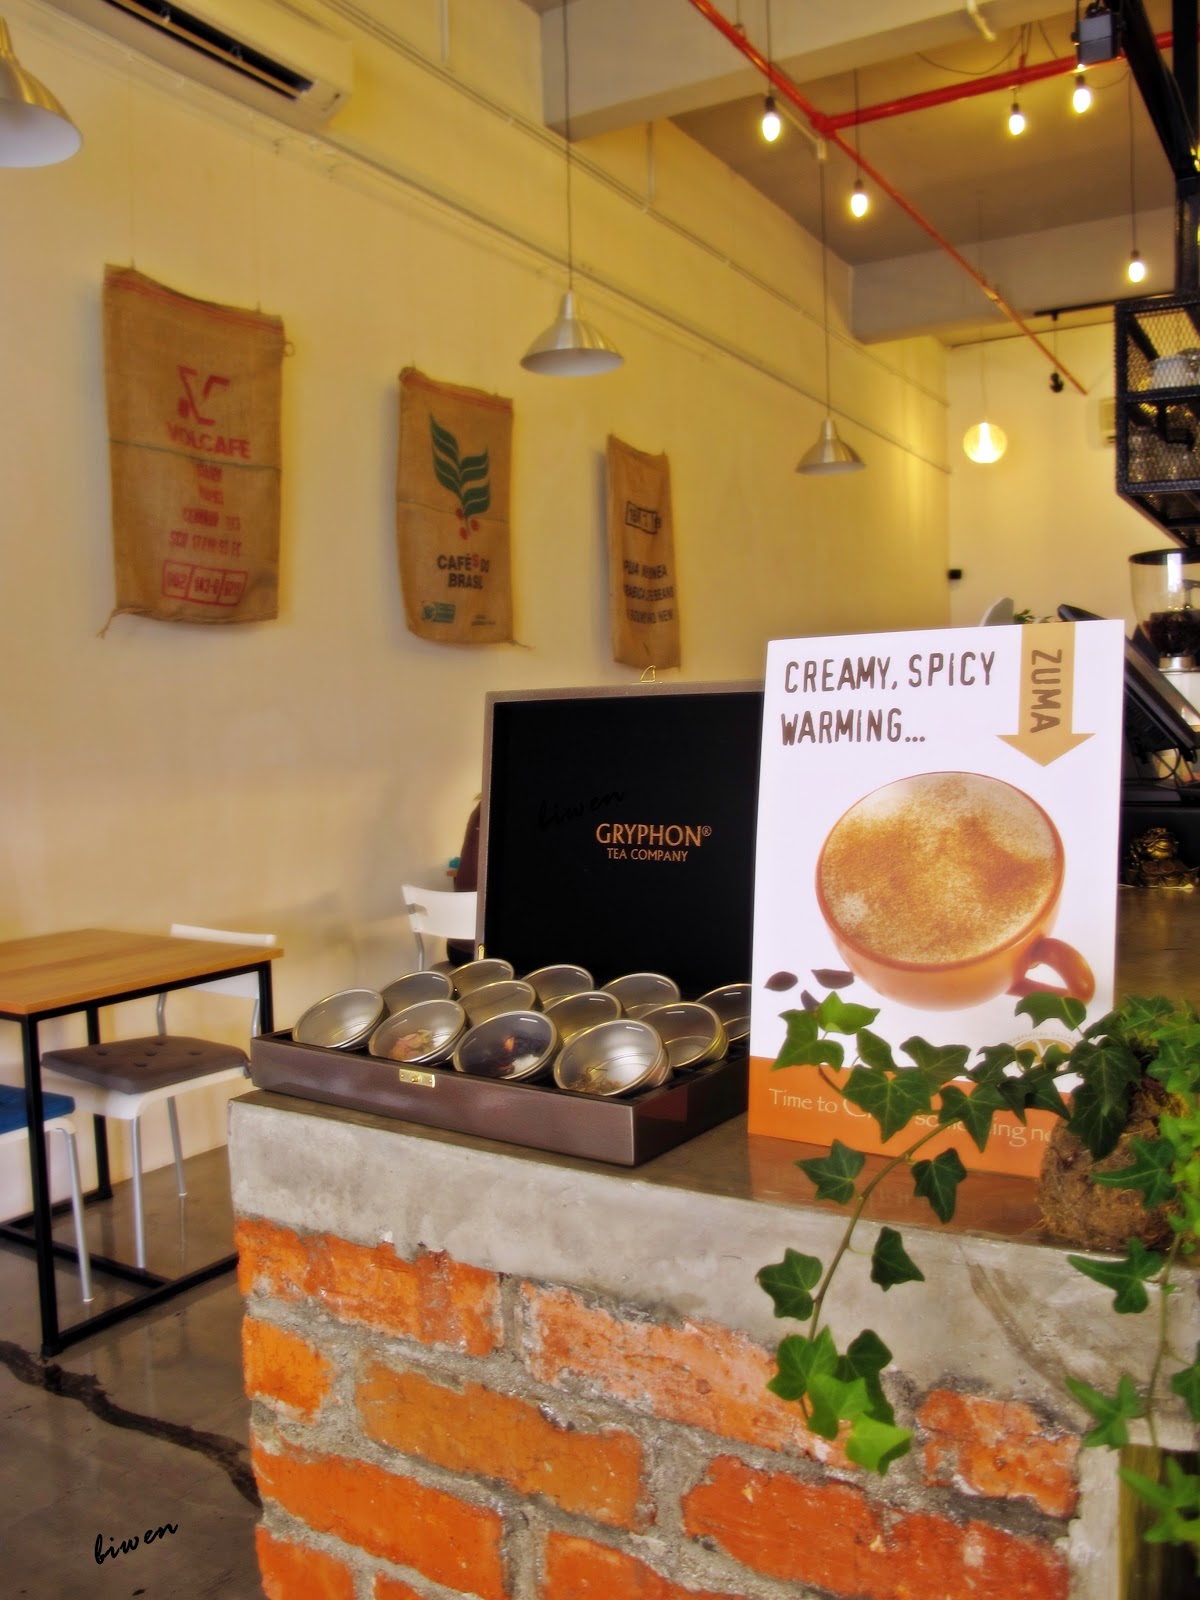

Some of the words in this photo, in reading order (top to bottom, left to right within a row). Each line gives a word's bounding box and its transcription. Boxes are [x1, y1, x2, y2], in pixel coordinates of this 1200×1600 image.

[784, 656, 898, 693] CREAMY,
[908, 651, 996, 688] SPICY
[1030, 649, 1062, 734] ZUMA
[781, 708, 926, 746] WARMING...
[607, 847, 627, 860] TEA
[630, 848, 688, 862] COMPANY
[768, 1088, 813, 1110] Time
[817, 1096, 838, 1113] to
